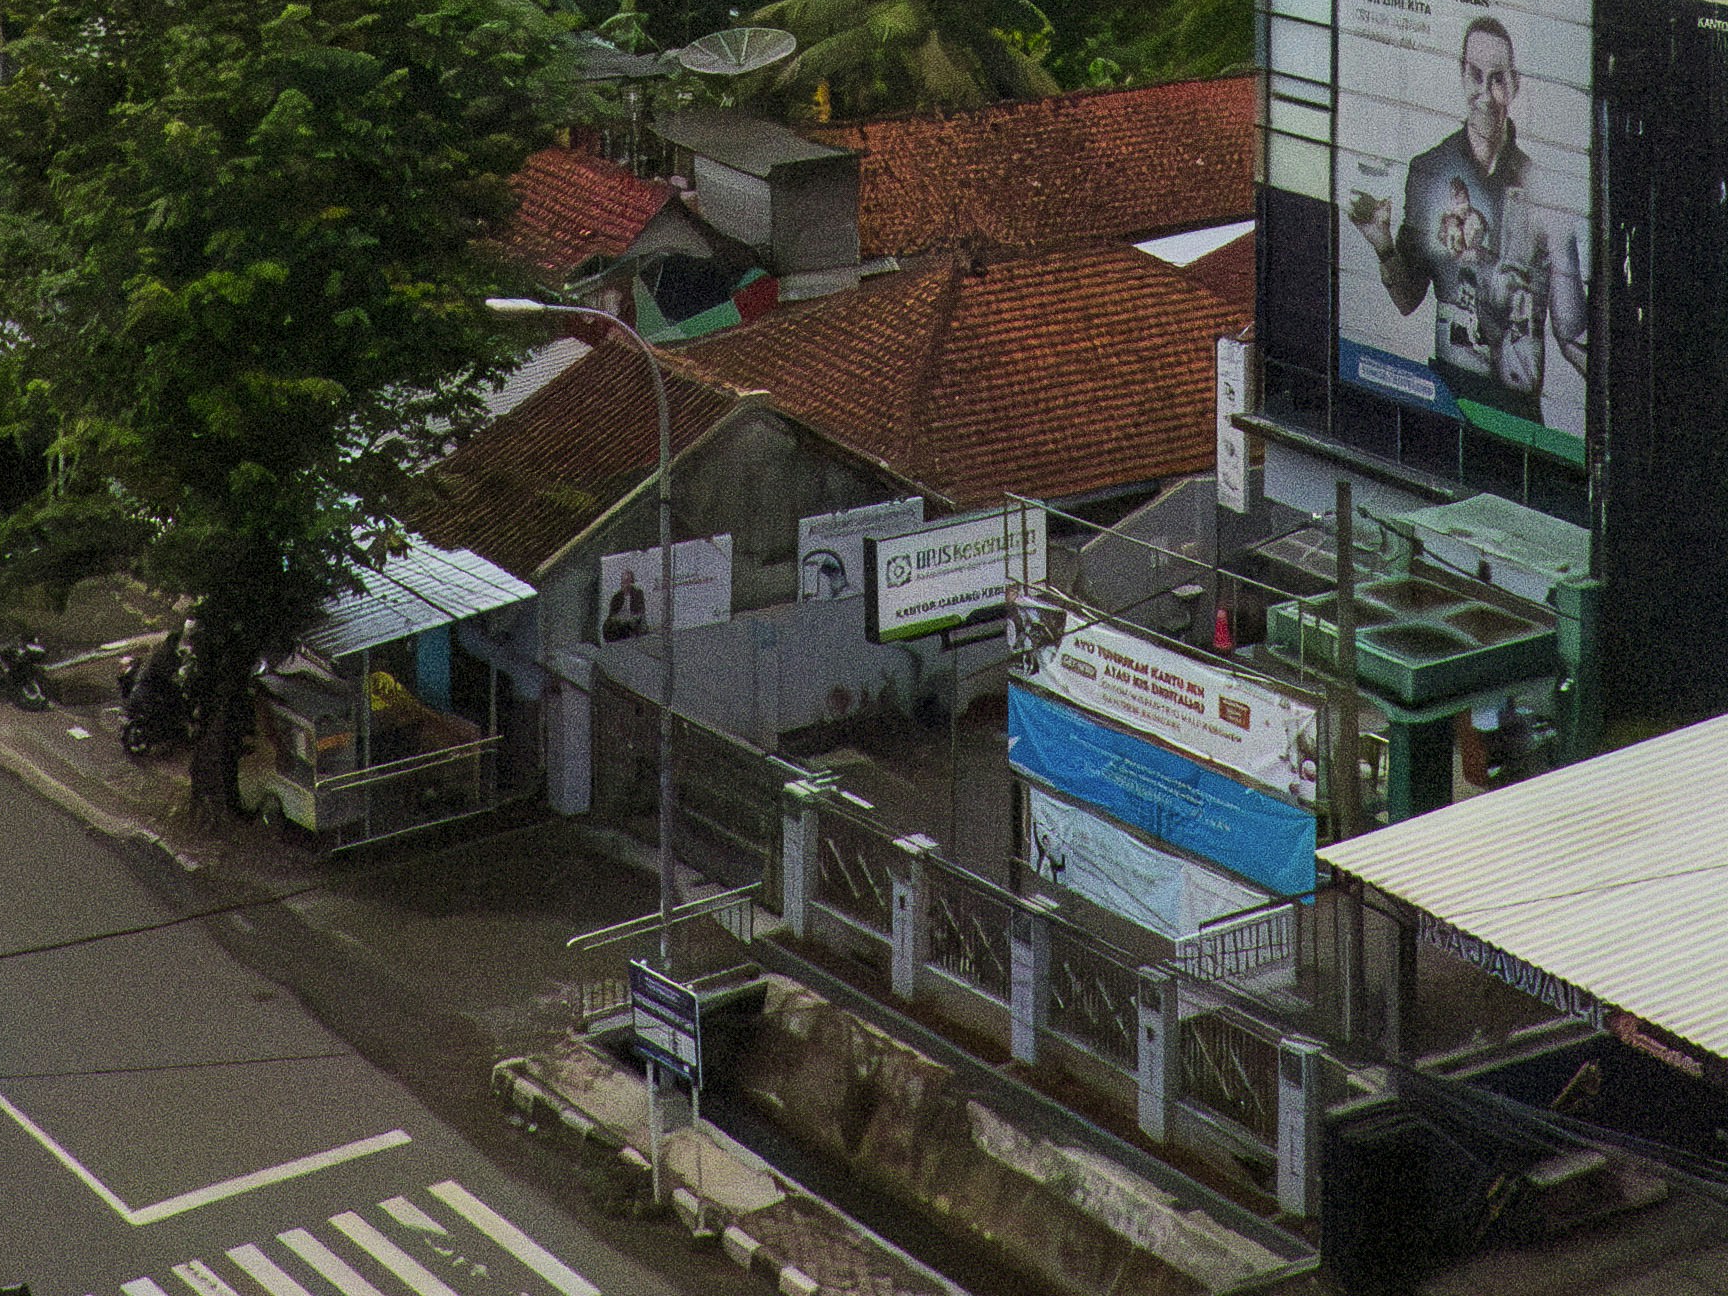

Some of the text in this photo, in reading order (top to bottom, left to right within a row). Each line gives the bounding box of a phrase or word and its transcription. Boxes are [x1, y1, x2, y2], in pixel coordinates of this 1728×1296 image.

[916, 544, 952, 571] BPJS
[896, 600, 936, 618] KANTOR
[938, 590, 981, 608] CABANG
